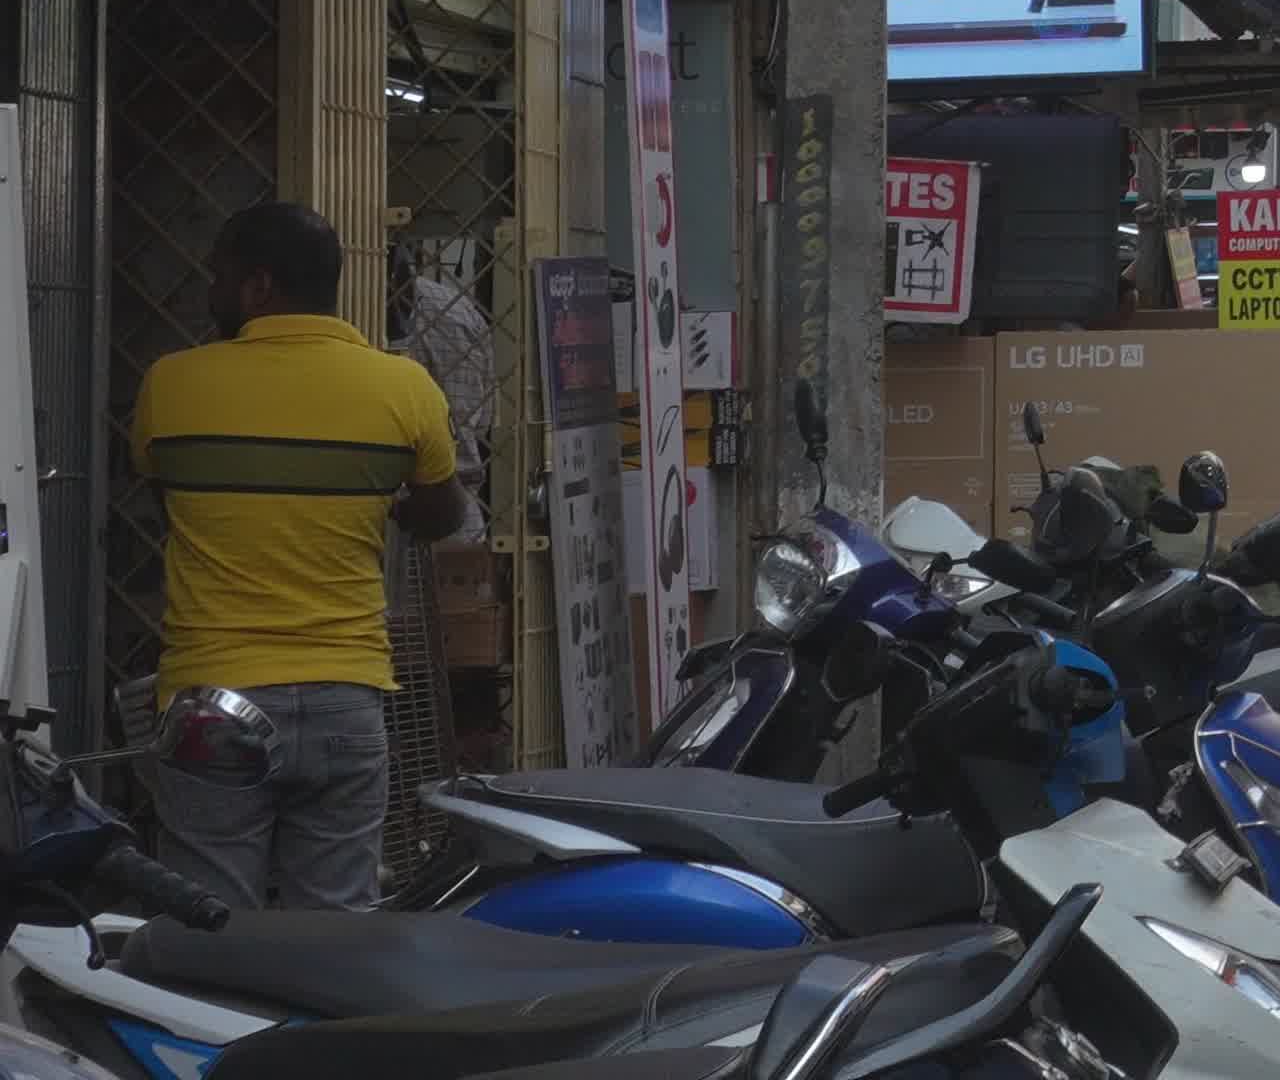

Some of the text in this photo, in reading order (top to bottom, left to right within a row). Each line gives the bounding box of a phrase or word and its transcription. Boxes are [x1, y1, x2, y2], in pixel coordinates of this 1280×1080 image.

[1009, 345, 1143, 369] LG UHD AI
